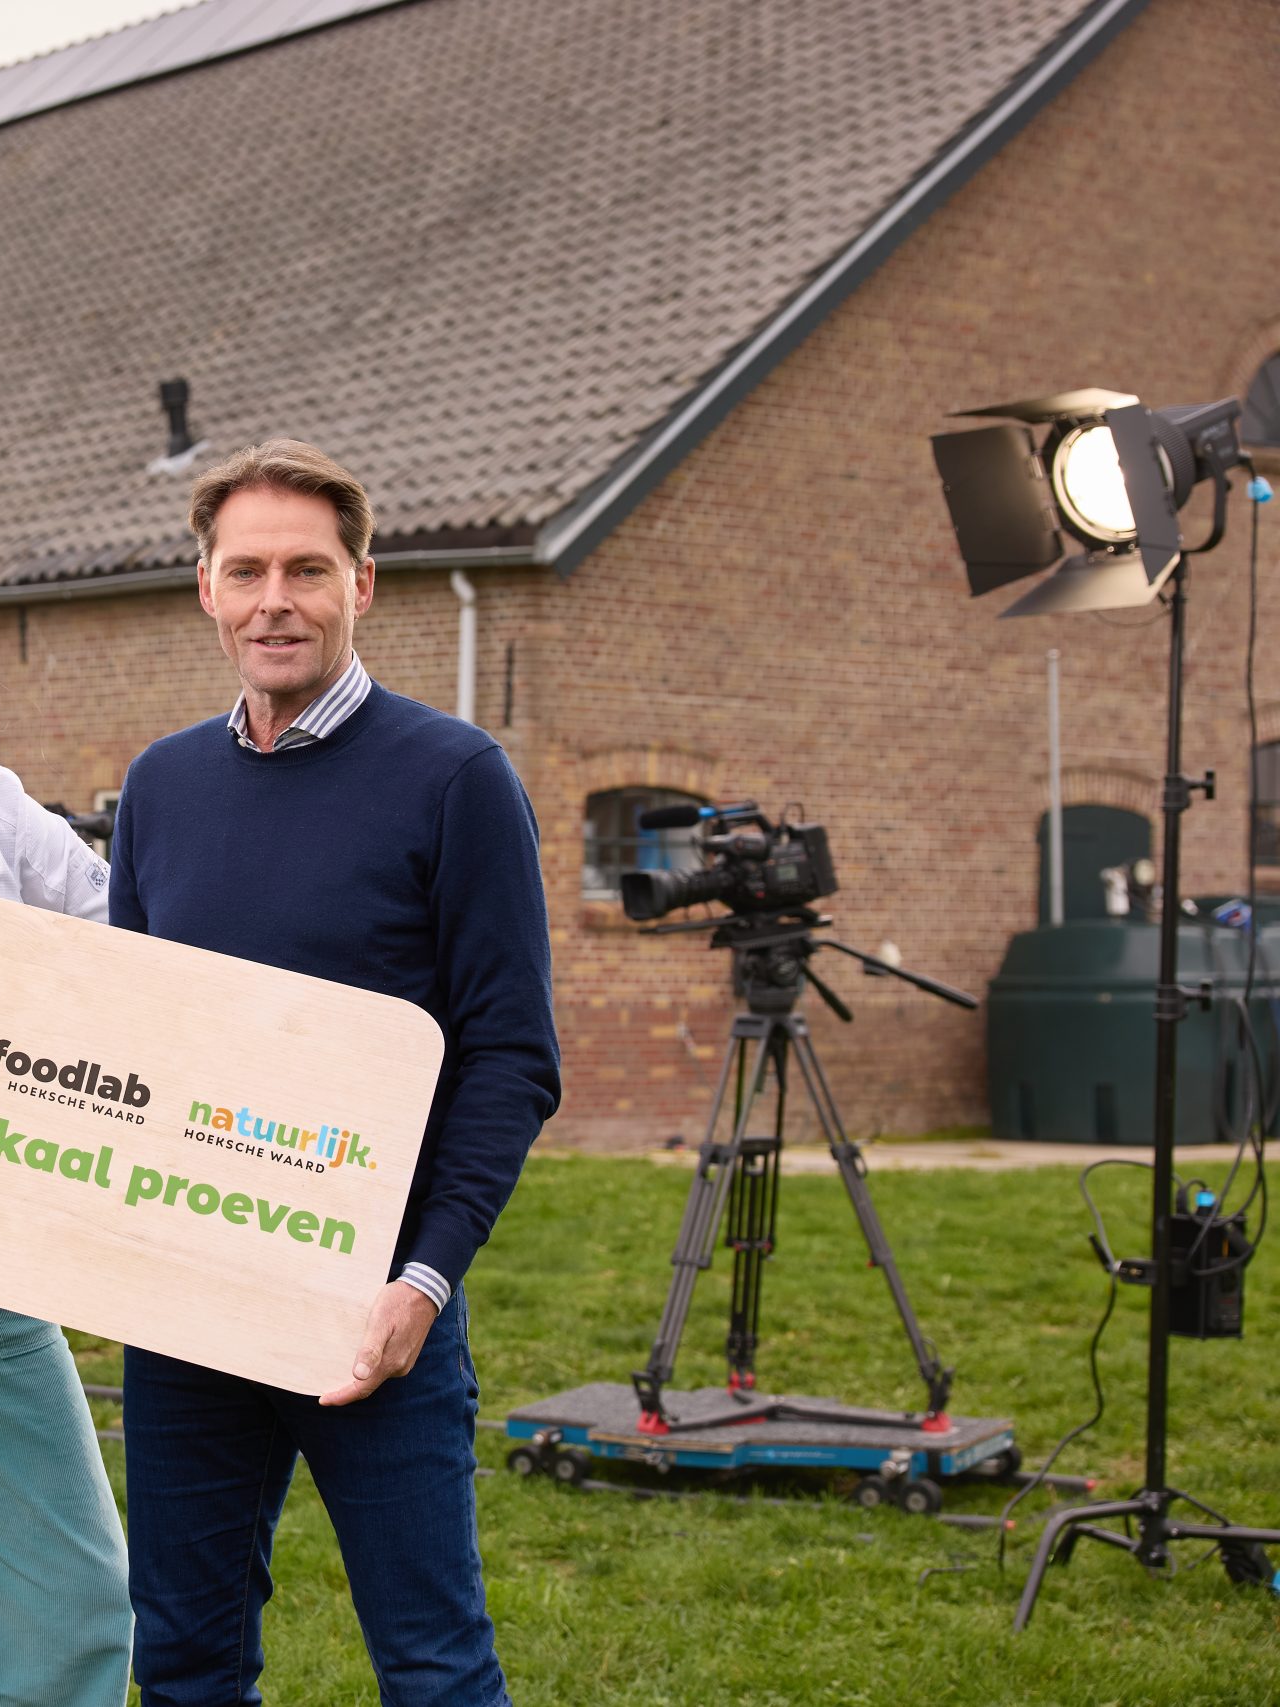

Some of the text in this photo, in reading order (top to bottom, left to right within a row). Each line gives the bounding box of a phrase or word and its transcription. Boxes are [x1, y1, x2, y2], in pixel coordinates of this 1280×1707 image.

[7, 1080, 145, 1126] HOEKSCHE WAARD
[183, 1127, 325, 1174] HOEKSCHE WAARD
[188, 1100, 377, 1169] natuurlijk.
[124, 1164, 356, 1255] proeven
